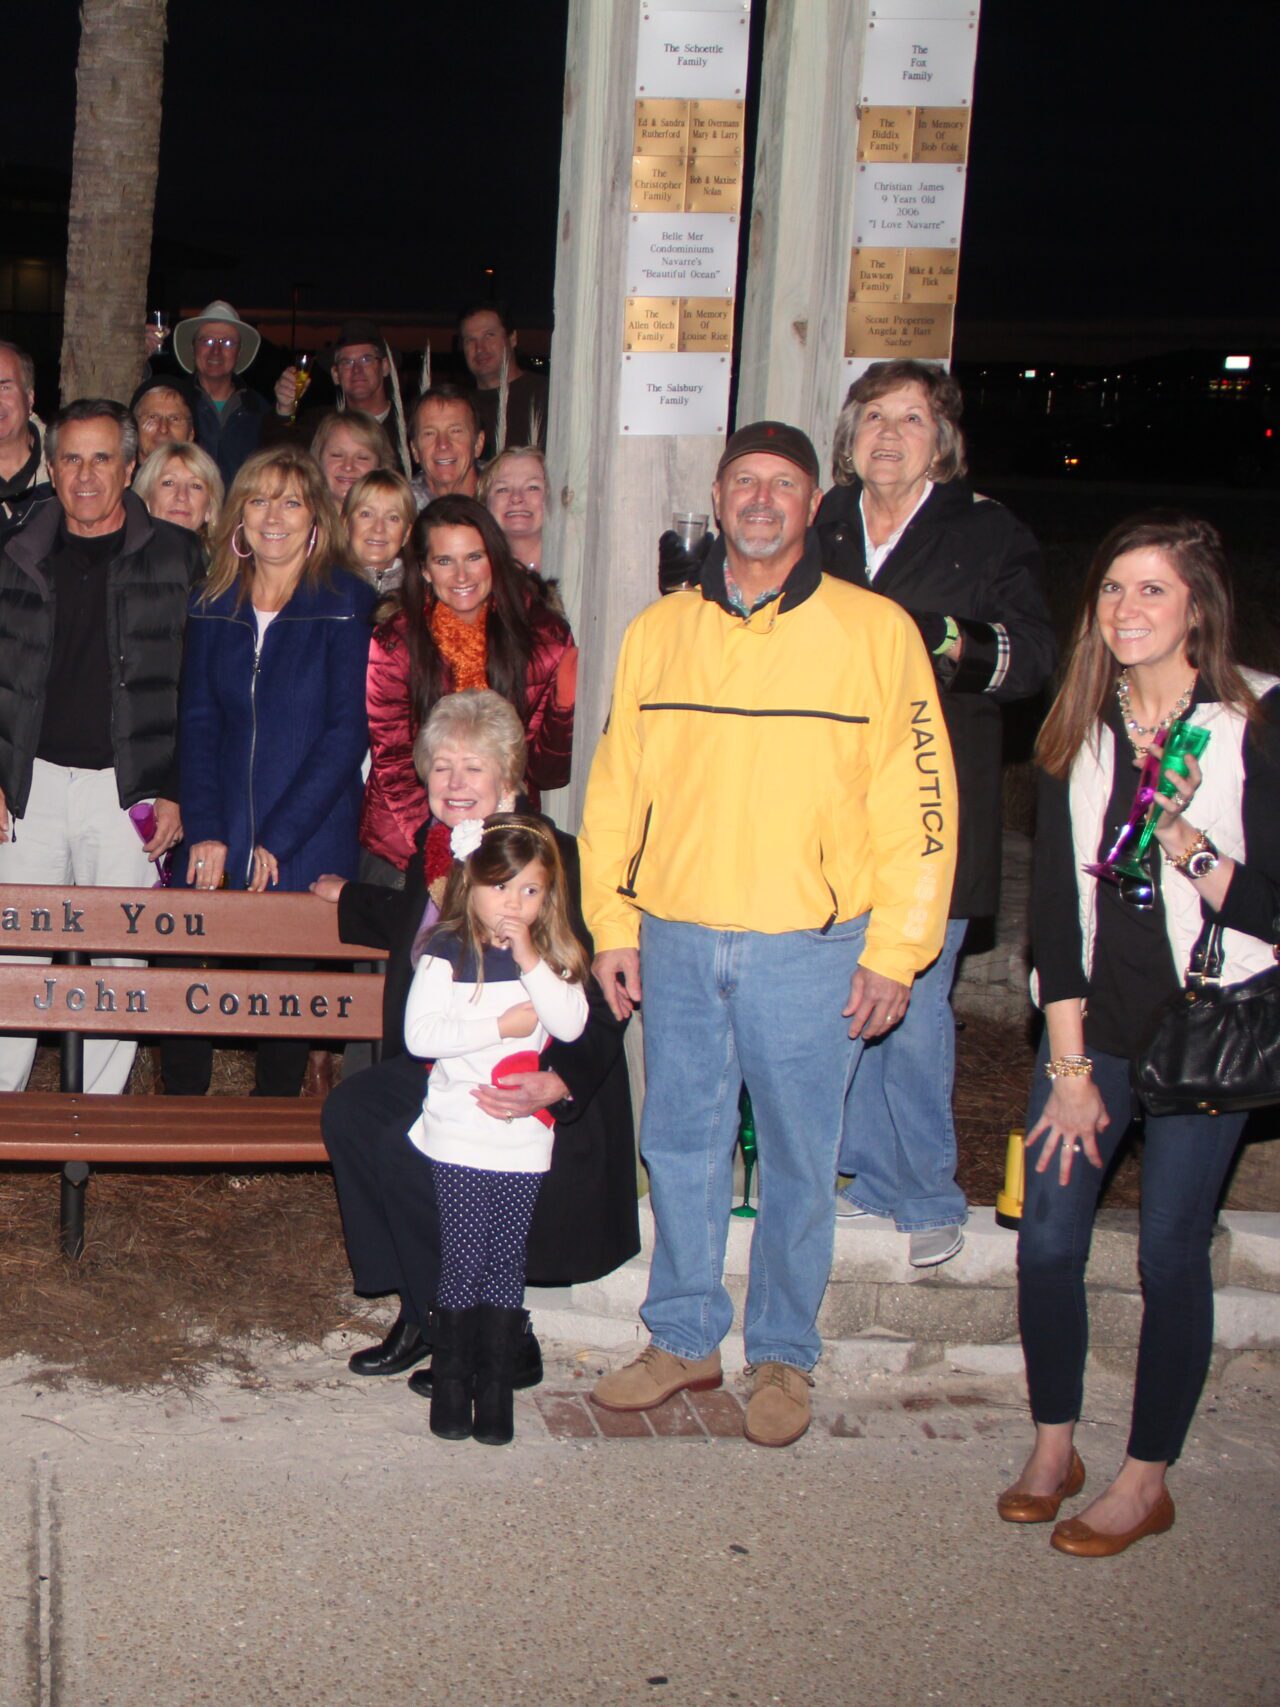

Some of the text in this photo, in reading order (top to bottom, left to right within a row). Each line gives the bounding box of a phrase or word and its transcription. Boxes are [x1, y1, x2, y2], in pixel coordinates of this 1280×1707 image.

[664, 43, 724, 53] The Schoettle
[912, 44, 929, 54] The
[677, 56, 708, 67] Family
[910, 58, 927, 68] Fox
[903, 71, 934, 81] Family
[638, 118, 648, 127] Ed
[660, 119, 686, 127] Sandra
[694, 118, 705, 127] The
[880, 118, 896, 128] The
[919, 120, 964, 130] In Memory
[641, 130, 681, 138] Rutherford
[692, 130, 709, 140] Mary
[721, 130, 739, 140] Larry
[935, 131, 945, 140] Of
[870, 141, 900, 152] Family
[920, 142, 938, 151] Bob
[651, 168, 668, 178] The
[690, 175, 702, 184] Bob
[634, 180, 682, 190] Christopher
[874, 182, 945, 191] Christian James
[643, 191, 673, 202] Family
[881, 194, 936, 204] 9 Years Old
[897, 207, 920, 216] 2006
[881, 220, 902, 229] Love
[662, 232, 704, 241] Belle Mer
[650, 244, 714, 254] Condominiums
[661, 257, 702, 266] Navarre's
[871, 260, 886, 269] The
[860, 271, 894, 280] Dawson
[861, 282, 891, 292] Family
[645, 310, 659, 318] The
[683, 310, 728, 319] In Memory
[628, 321, 649, 329] Allen
[700, 321, 710, 329] Of
[682, 332, 729, 340] Louise Rice
[868, 327, 897, 336] Angela
[637, 332, 665, 342] Family
[646, 383, 704, 393] The Salsbury
[660, 396, 689, 406] Family
[910, 700, 944, 857] NAUTICA
[120, 901, 206, 936] You
[33, 977, 149, 1013] John
[185, 982, 353, 1018] Conner
